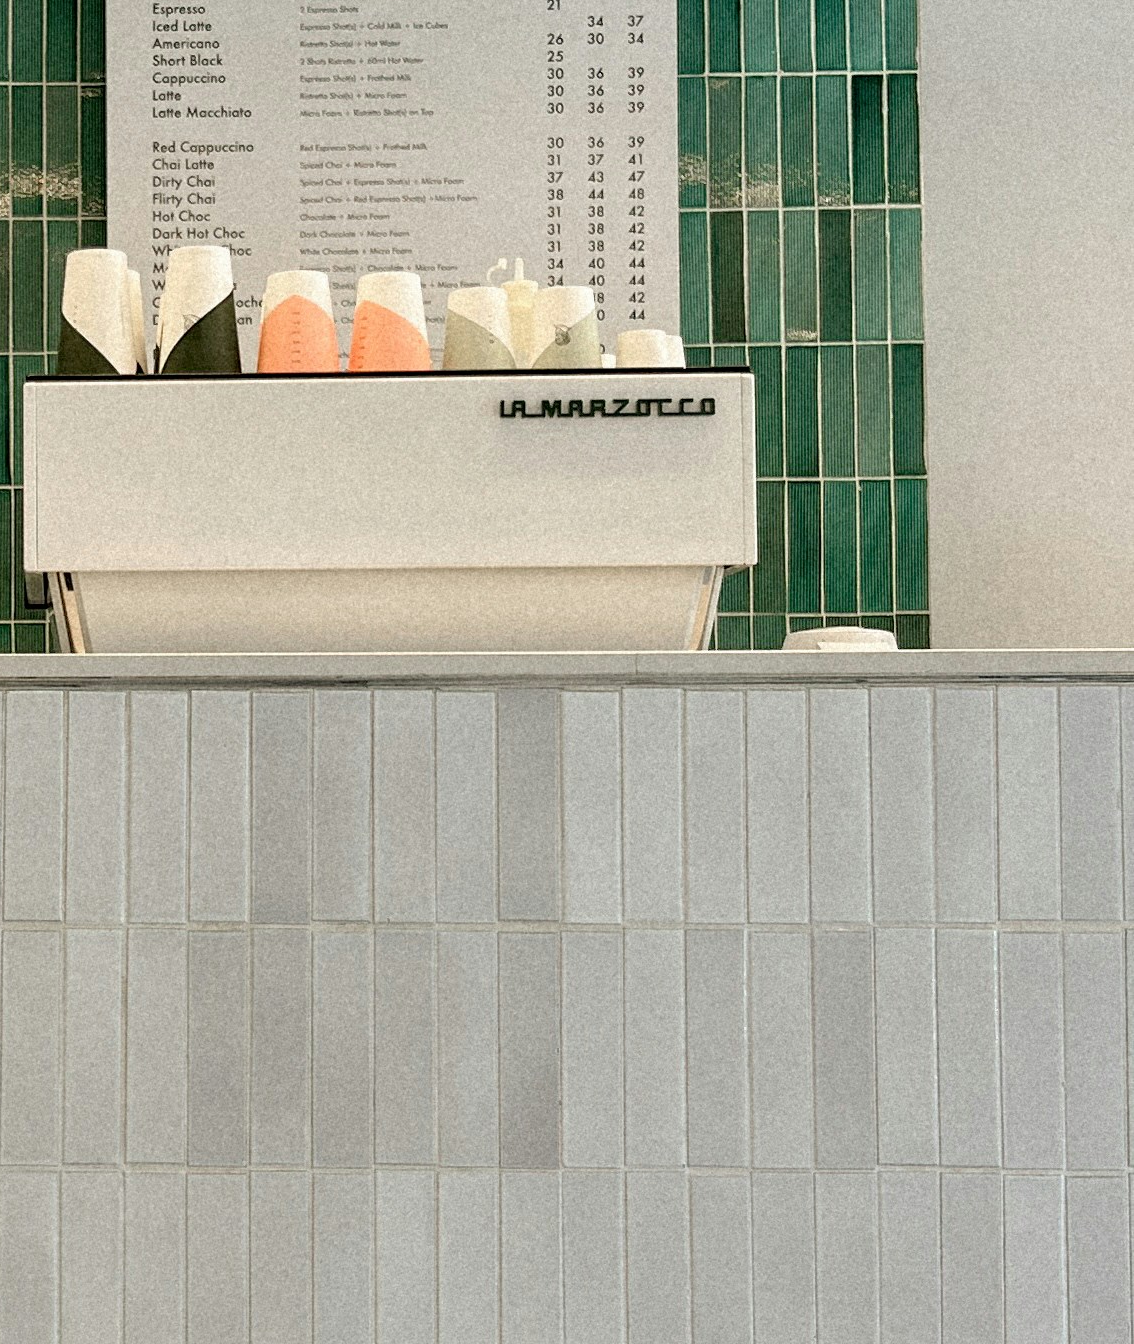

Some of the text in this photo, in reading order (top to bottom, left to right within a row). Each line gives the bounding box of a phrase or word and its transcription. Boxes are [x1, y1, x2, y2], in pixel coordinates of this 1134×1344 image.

[153, 3, 205, 16] Espresso
[547, 0, 560, 10] 21
[153, 20, 211, 31] Iced Latte
[588, 15, 644, 27] 34 37
[153, 38, 219, 49] Americano
[548, 33, 644, 45] 26 30 34
[153, 54, 222, 66] Short Black
[548, 51, 563, 62] 25
[152, 72, 226, 85] Cappuccino
[548, 67, 644, 79] 30 36 39
[153, 91, 181, 101] Latte
[548, 84, 644, 96] 30 36 39
[153, 106, 251, 118] Latte Macchiato
[548, 102, 644, 114] 30 36 39
[153, 141, 254, 155] Red Cappuccino
[548, 136, 644, 148] 30 36 39
[152, 159, 214, 170] Chai Latte
[548, 154, 642, 165] 31 37 41
[153, 176, 214, 189] Dirty Chai
[548, 171, 644, 183] 37 43 47
[153, 193, 215, 207] Flirty Chai
[548, 188, 644, 200] 38 44 48
[153, 210, 209, 221] Hot Choc
[548, 206, 644, 217] 31 38 42
[153, 227, 245, 239] Dark Hot Choc
[548, 223, 644, 235] 31 38 42
[548, 240, 644, 252] 31 38 42
[548, 258, 645, 269] 34 40 44
[548, 275, 645, 287] 34 40 44
[629, 292, 645, 303] 42
[629, 310, 645, 320] 44
[499, 398, 528, 419] LA
